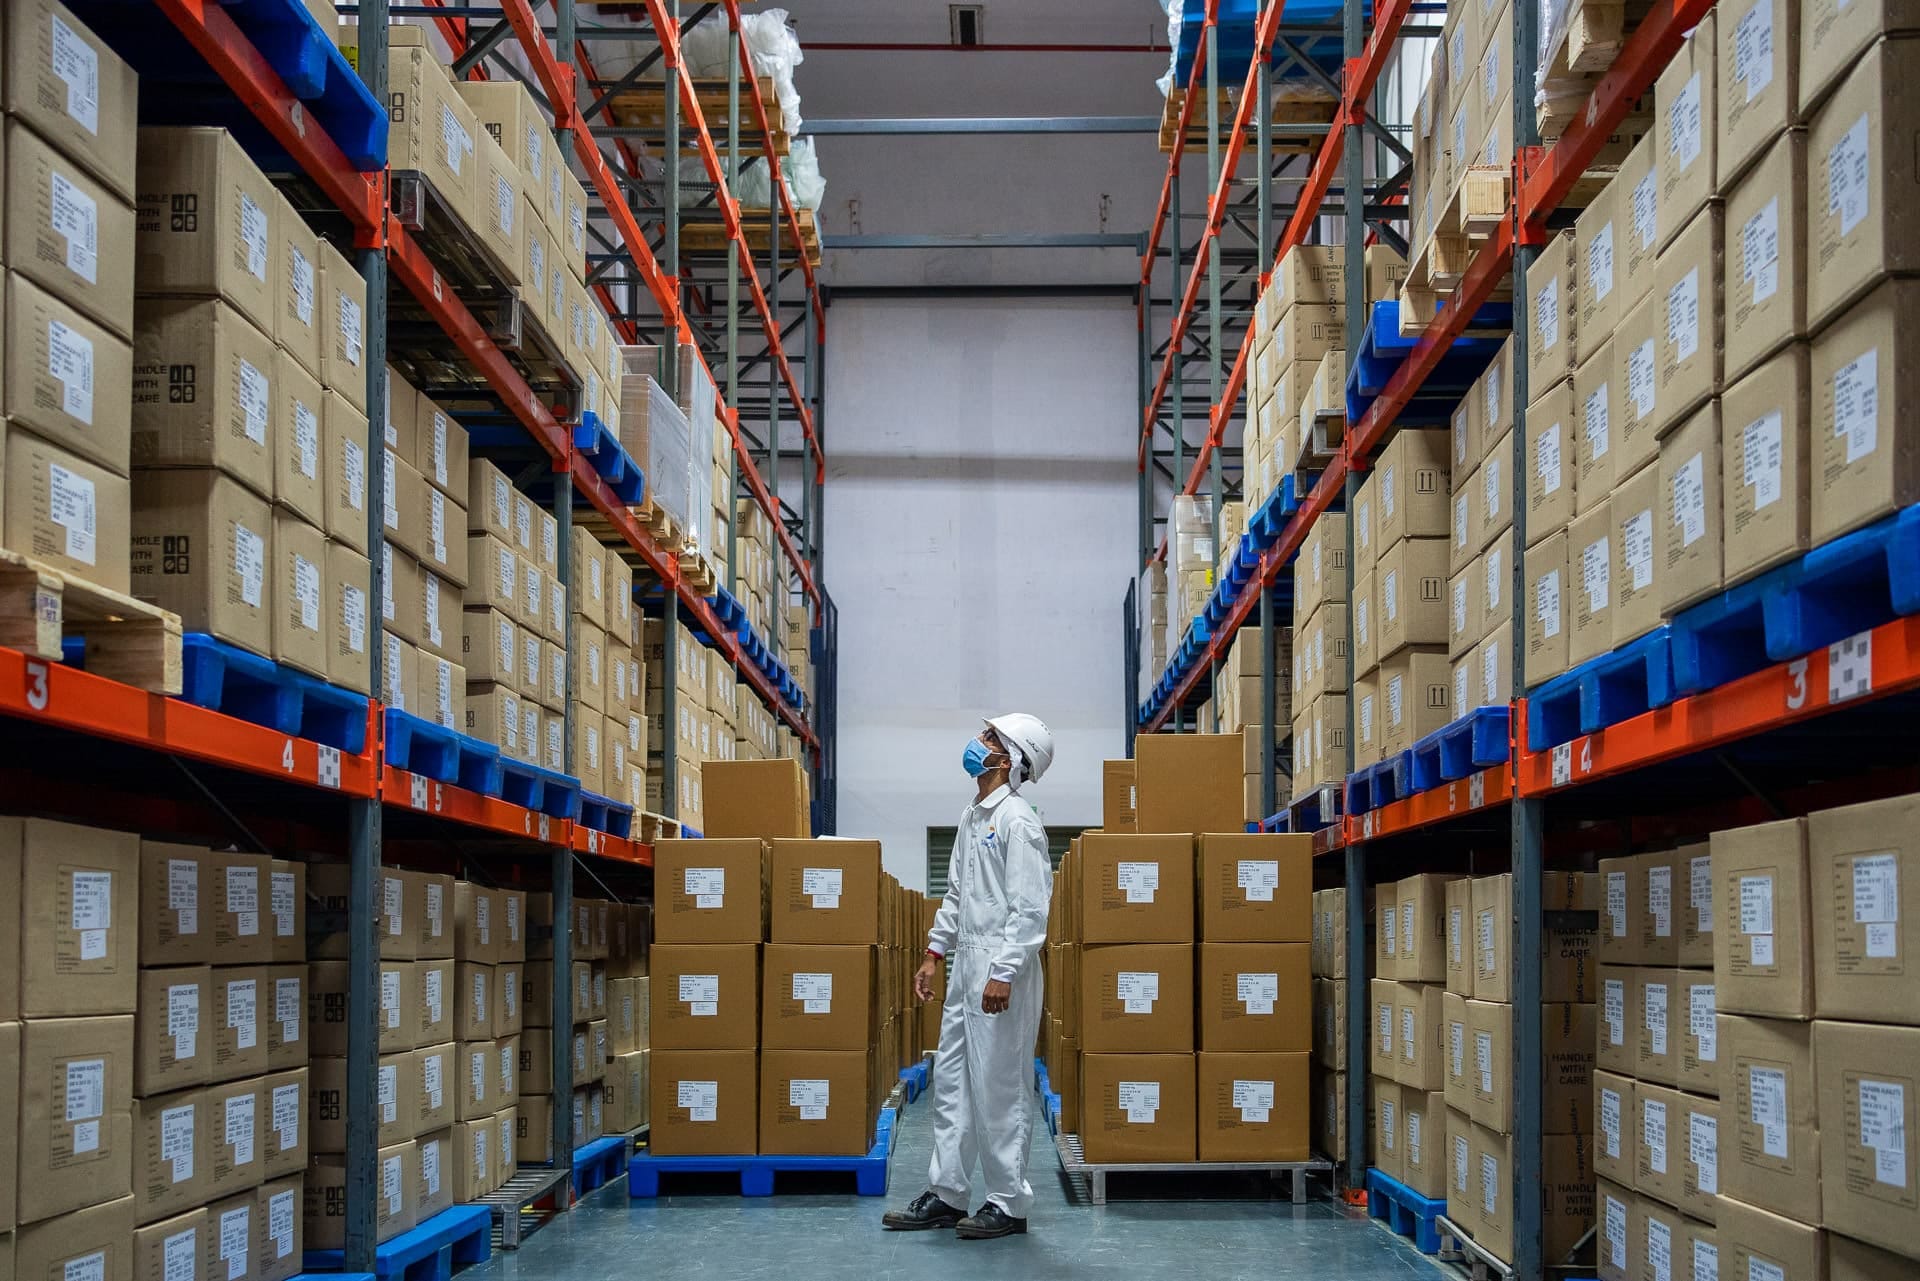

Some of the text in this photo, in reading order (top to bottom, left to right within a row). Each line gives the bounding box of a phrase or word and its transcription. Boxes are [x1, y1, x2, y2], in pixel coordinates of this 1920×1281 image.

[136, 194, 168, 203] ANDLE
[137, 222, 160, 231] ARE
[132, 365, 168, 374] ANDLE
[131, 536, 160, 546] NDLE
[131, 566, 153, 574] ARE
[27, 662, 48, 710] 3
[1787, 658, 1808, 710] 3
[282, 740, 294, 772] 4
[1580, 736, 1592, 774] 4
[434, 783, 442, 811] 5
[1450, 784, 1456, 811] 5
[525, 812, 531, 834] 6
[601, 835, 606, 853] 7
[1562, 938, 1589, 947] WITH
[1561, 950, 1590, 958] CARE
[1552, 1053, 1593, 1062] HANDLE
[1560, 1065, 1586, 1073] WITH
[1559, 1077, 1587, 1085] CARE
[1566, 1196, 1592, 1204] WITH
[1565, 1207, 1593, 1216] CARE
